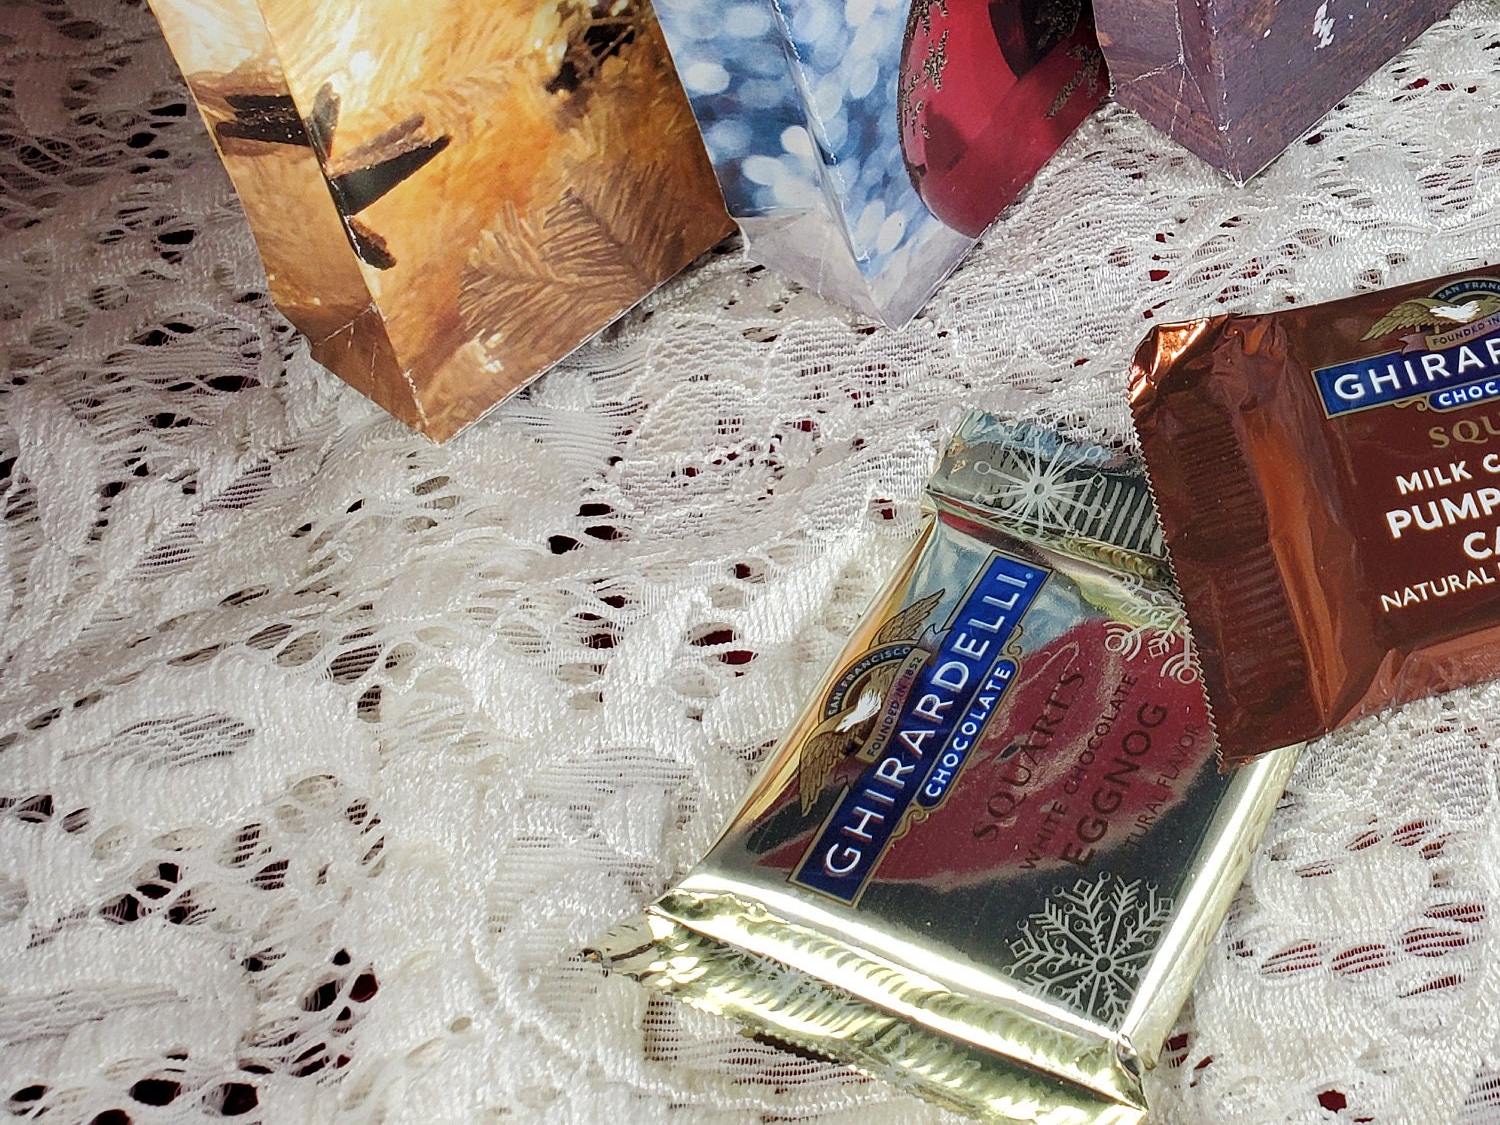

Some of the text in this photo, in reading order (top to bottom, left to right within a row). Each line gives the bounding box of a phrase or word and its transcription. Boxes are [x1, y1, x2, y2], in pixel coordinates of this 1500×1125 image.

[1441, 285, 1460, 300] SAN
[1433, 322, 1485, 346] FOUNDED
[1487, 316, 1500, 326] IN
[1395, 459, 1473, 496] MILK
[1380, 566, 1496, 613] NATURAL
[828, 646, 911, 715] SAN FRANCISCO
[867, 700, 900, 757] FOUNDED
[904, 656, 923, 680] 1852
[825, 573, 1028, 876] GHIRARDELLI
[925, 665, 1012, 798] CHOCOLATE
[1019, 674, 1139, 870] WHITE CHOCOLATE
[1061, 701, 1168, 867] EGGNOG
[1124, 787, 1167, 847] TURAL
